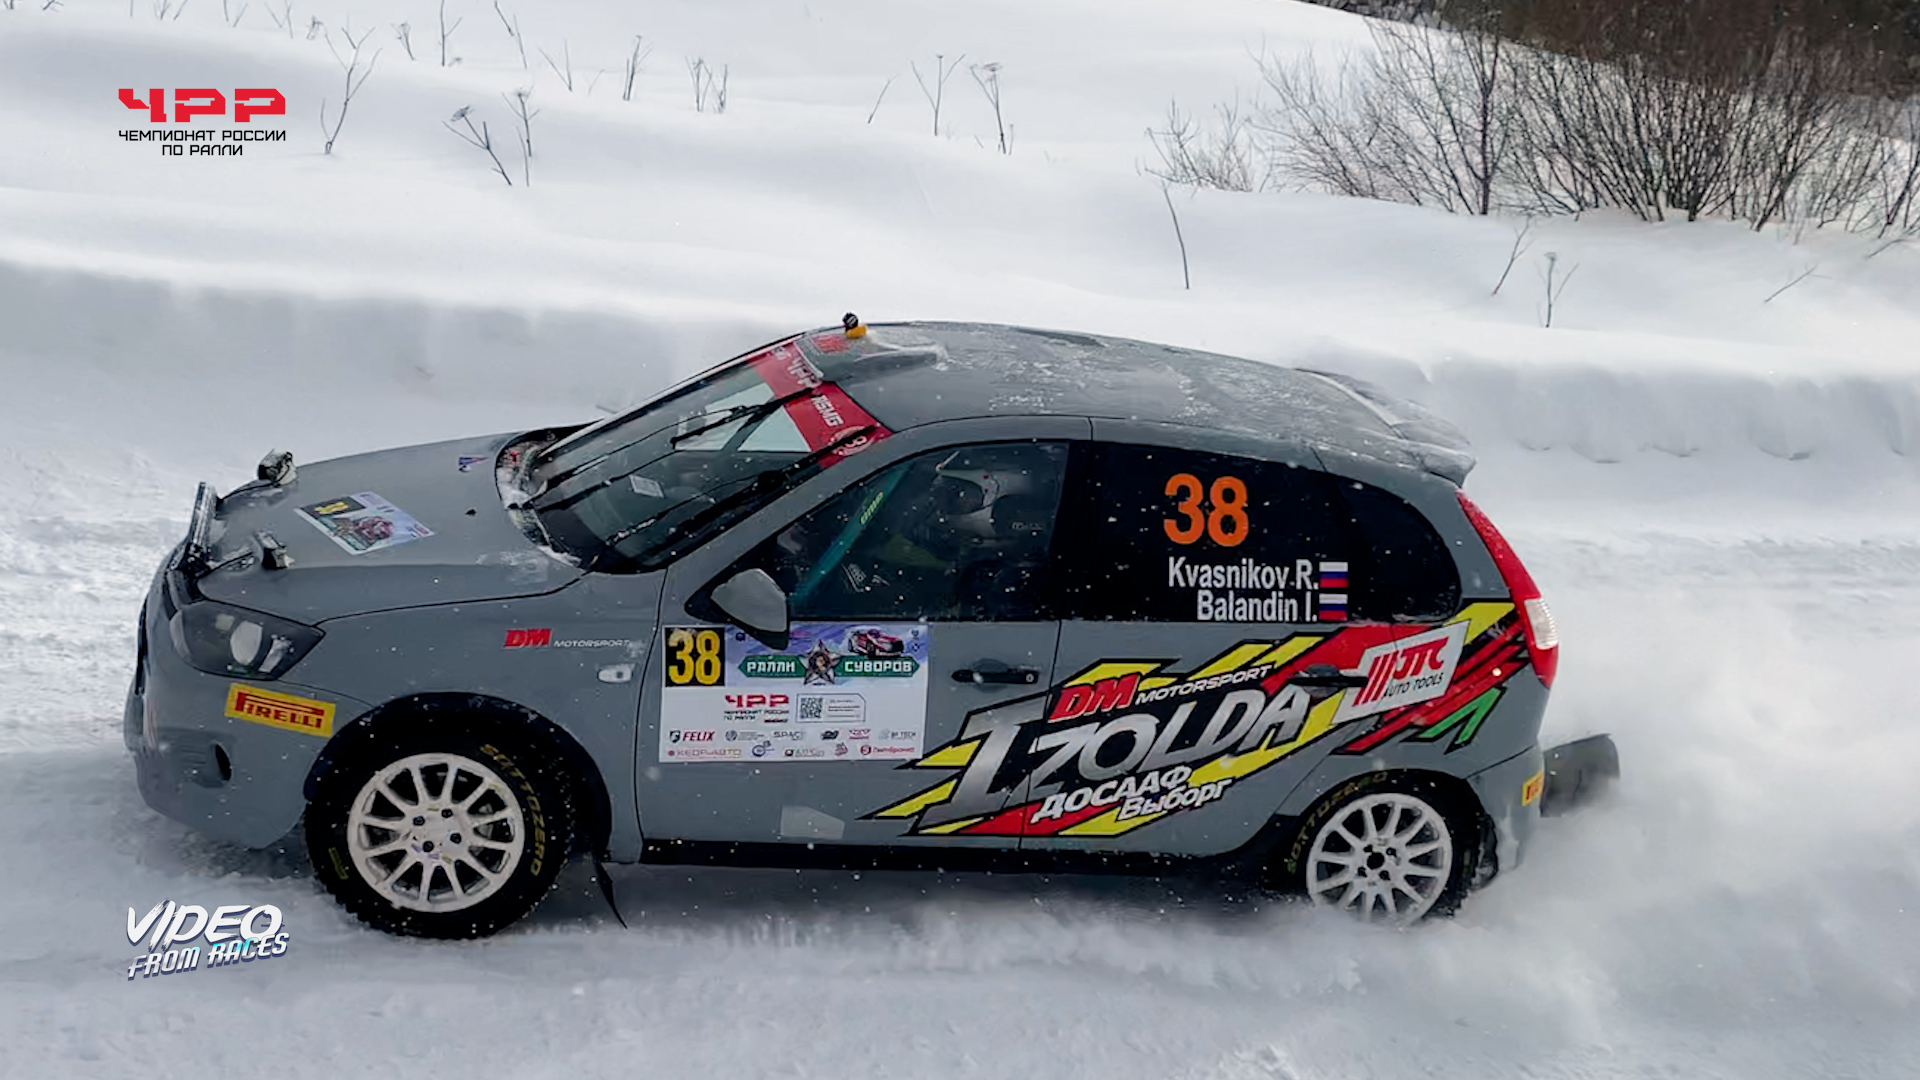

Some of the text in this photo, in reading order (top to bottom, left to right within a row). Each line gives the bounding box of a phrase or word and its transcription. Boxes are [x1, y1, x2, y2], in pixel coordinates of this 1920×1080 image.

[1164, 473, 1249, 547] 38
[1168, 556, 1319, 590] Kvasnikov R.
[1197, 589, 1318, 622] Balandin I.
[505, 628, 630, 650] DM MOTORSPORT
[668, 629, 721, 685] 38
[746, 661, 913, 674] РАЛЛИ СУВОРОВ
[1048, 664, 1273, 724] DM MOTORSPORT
[1413, 672, 1445, 690] TOOLS
[235, 691, 325, 729] PIRELLI
[724, 694, 790, 709] ЧРР
[682, 731, 715, 742] FELIX
[1029, 765, 1193, 825] ДОСААФ
[1117, 779, 1233, 821] Выборг
